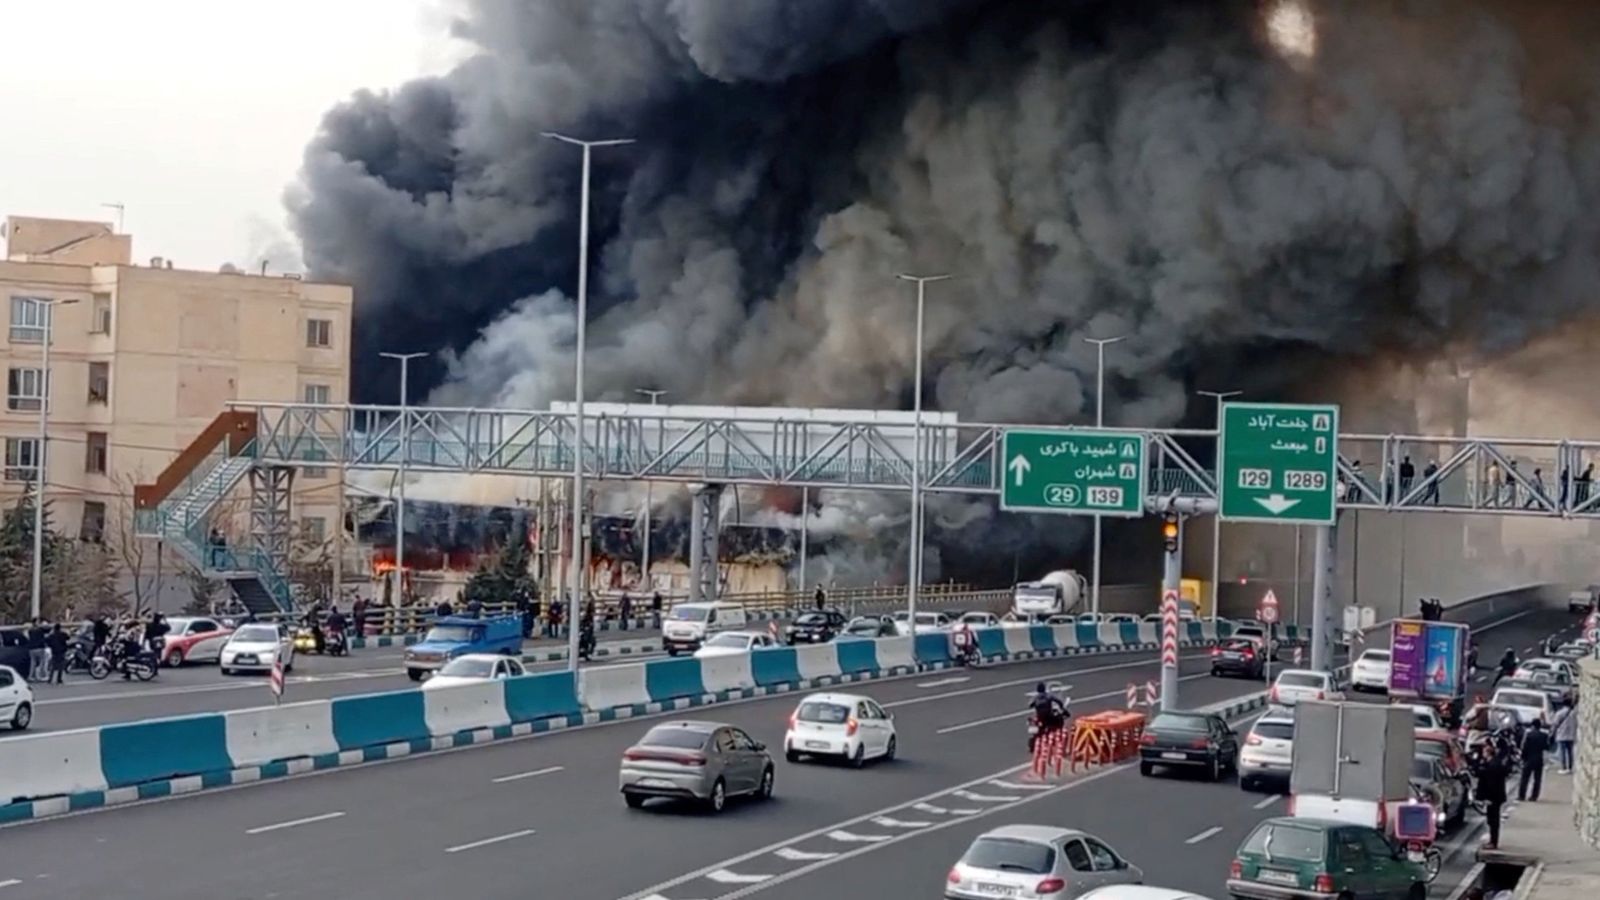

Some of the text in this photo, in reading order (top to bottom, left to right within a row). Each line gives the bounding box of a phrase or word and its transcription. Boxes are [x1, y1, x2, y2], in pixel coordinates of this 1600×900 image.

[1248, 414, 1309, 431] جنت آباد
[1040, 441, 1117, 458] شهید باکری
[1270, 439, 1308, 454] مبعث
[1075, 464, 1116, 480] شهران
[1242, 471, 1325, 488] 129 1289
[1050, 487, 1120, 504] 29 139
